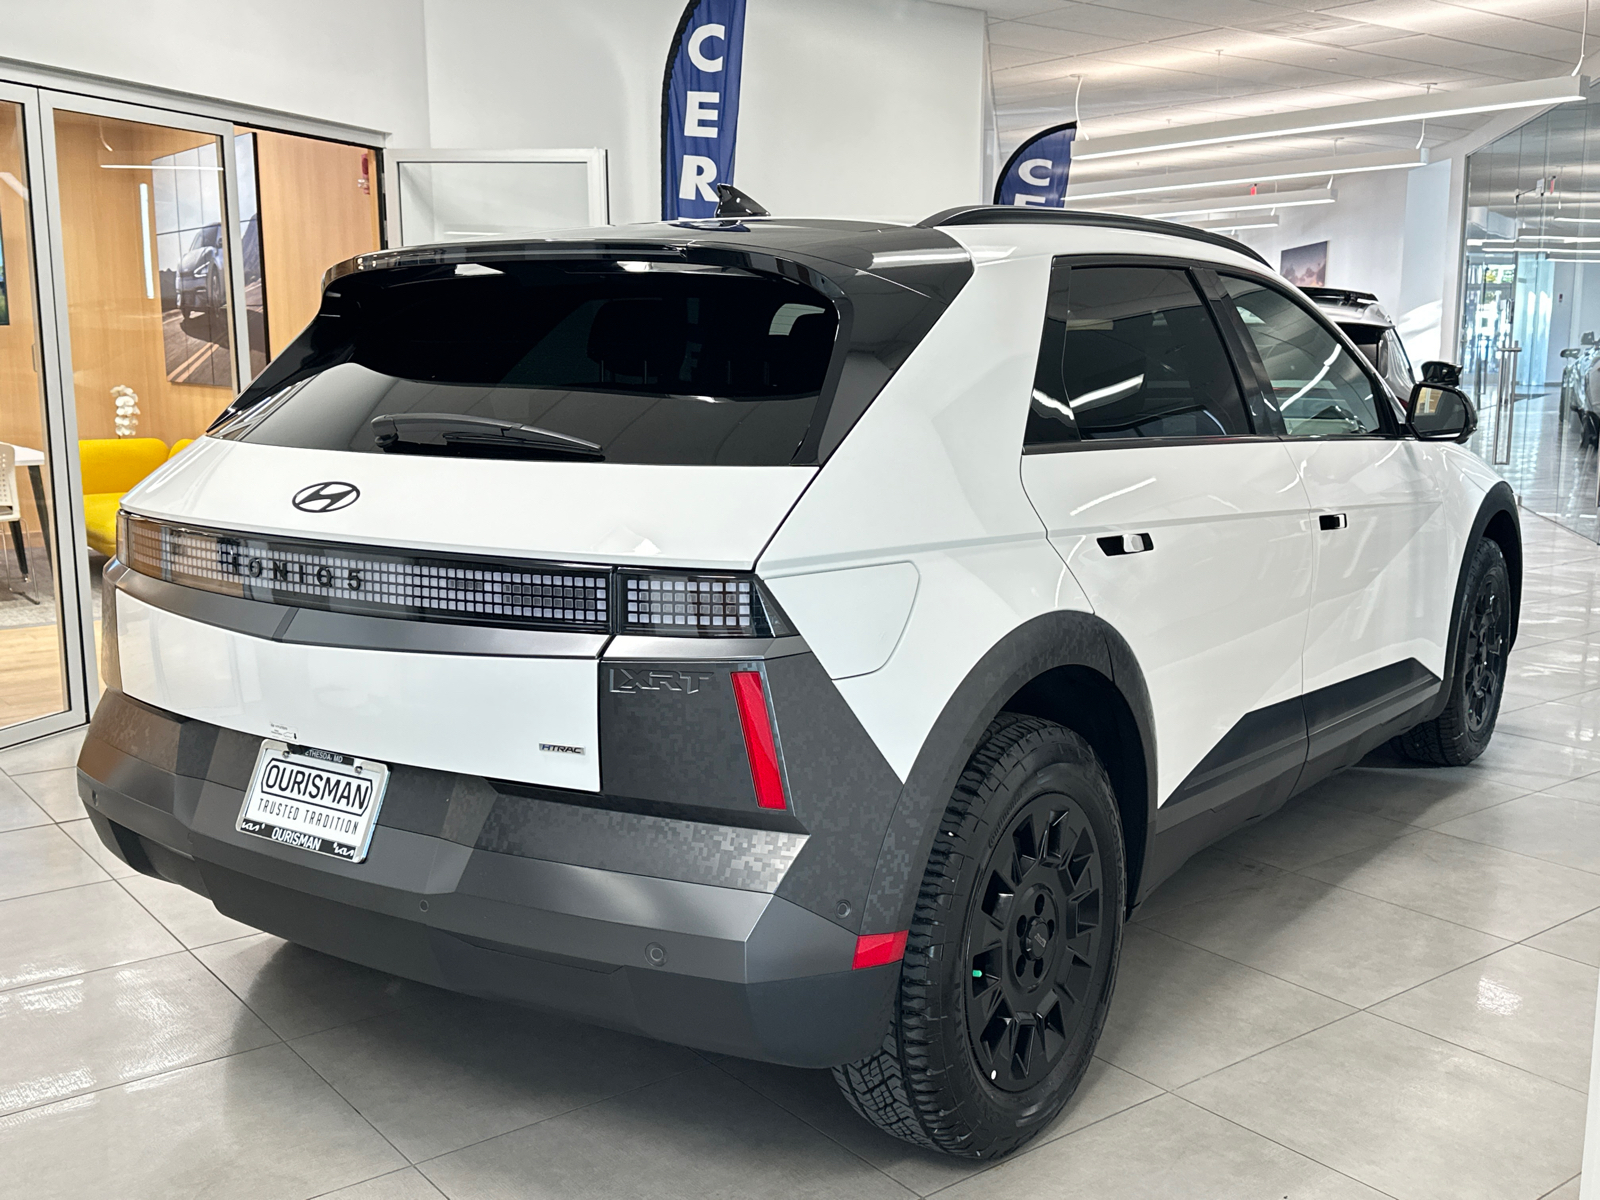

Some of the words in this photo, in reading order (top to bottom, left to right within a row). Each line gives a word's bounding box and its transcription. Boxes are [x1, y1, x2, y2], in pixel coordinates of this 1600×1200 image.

[232, 554, 334, 588] IONIQ
[347, 568, 363, 592] 5
[333, 754, 343, 763] MD
[541, 744, 582, 754] HTRAC
[265, 764, 369, 810] OURISMAN
[257, 798, 300, 821] TRUSTED
[303, 809, 360, 835] TRADITION
[271, 827, 322, 851] OURISMAN
